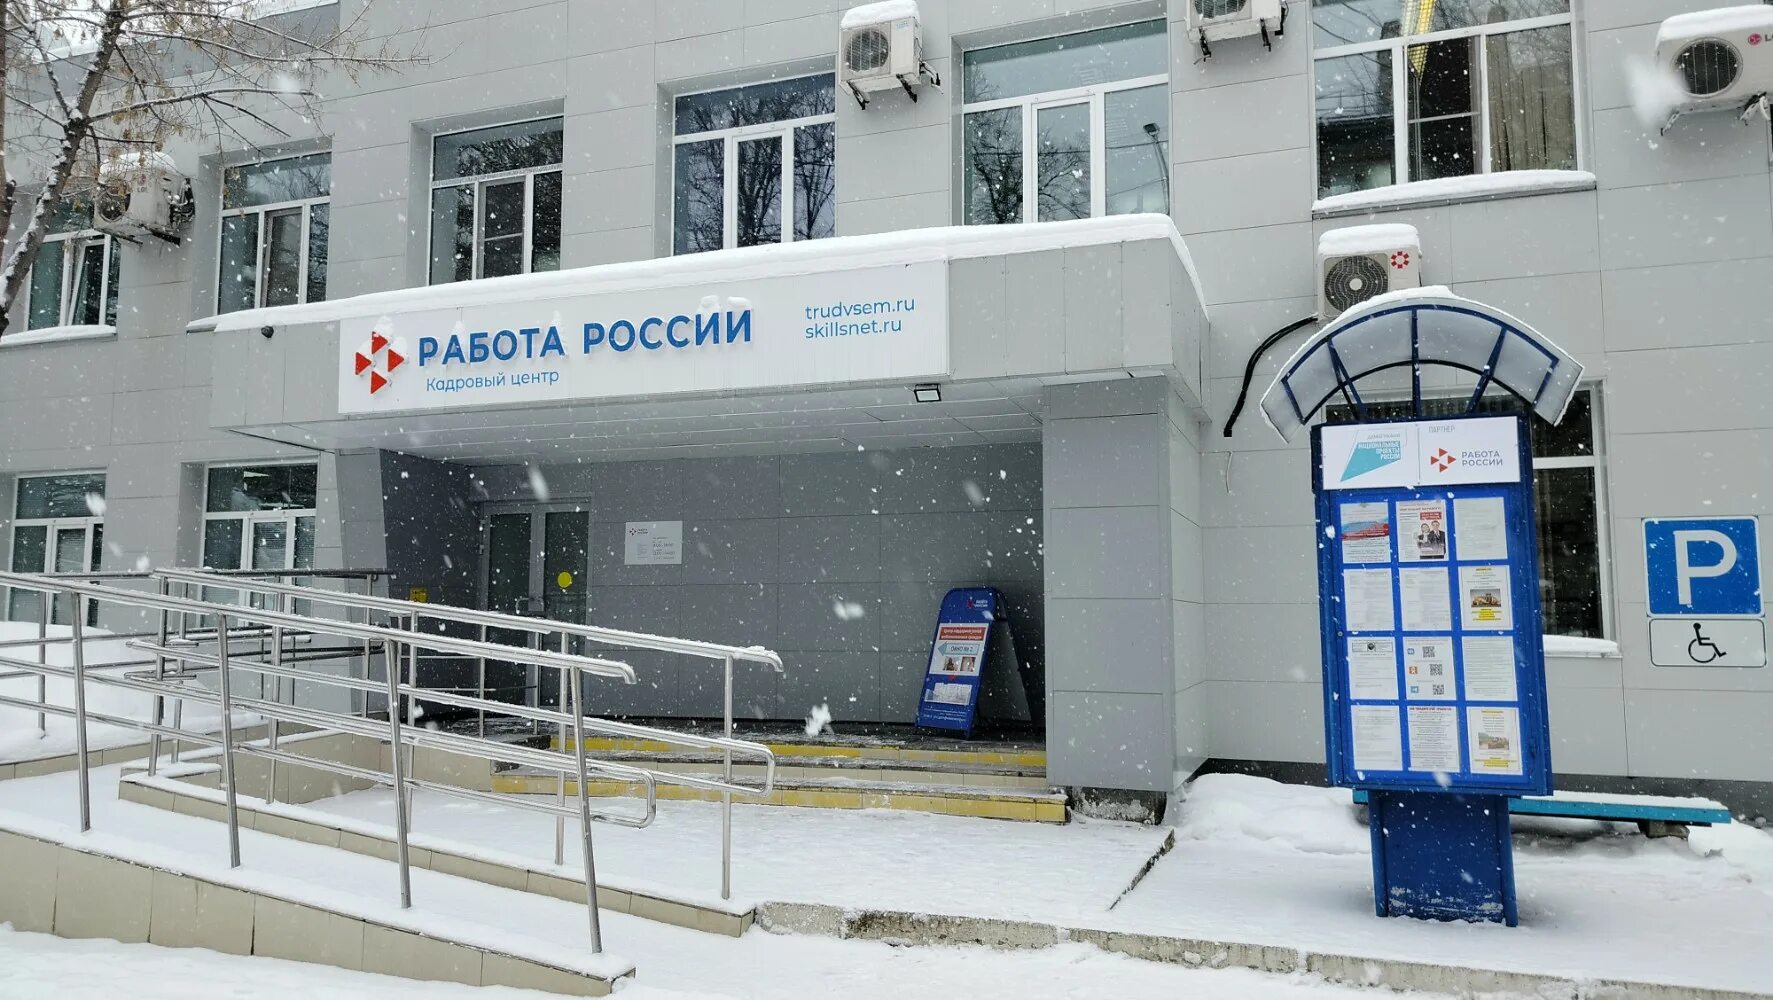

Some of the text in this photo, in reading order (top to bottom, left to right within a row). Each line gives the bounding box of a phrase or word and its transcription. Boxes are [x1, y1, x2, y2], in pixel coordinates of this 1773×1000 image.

[1764, 33, 1773, 42] L
[804, 298, 915, 320] trudvsem.ru
[418, 309, 752, 367] РАБОТА РОССИИ
[805, 319, 903, 339] skillsnet.ru
[426, 370, 560, 393] Кадровый центр
[1461, 450, 1501, 459] РАБОТА
[1461, 458, 1504, 467] РОССИИ
[1673, 529, 1737, 606] P
